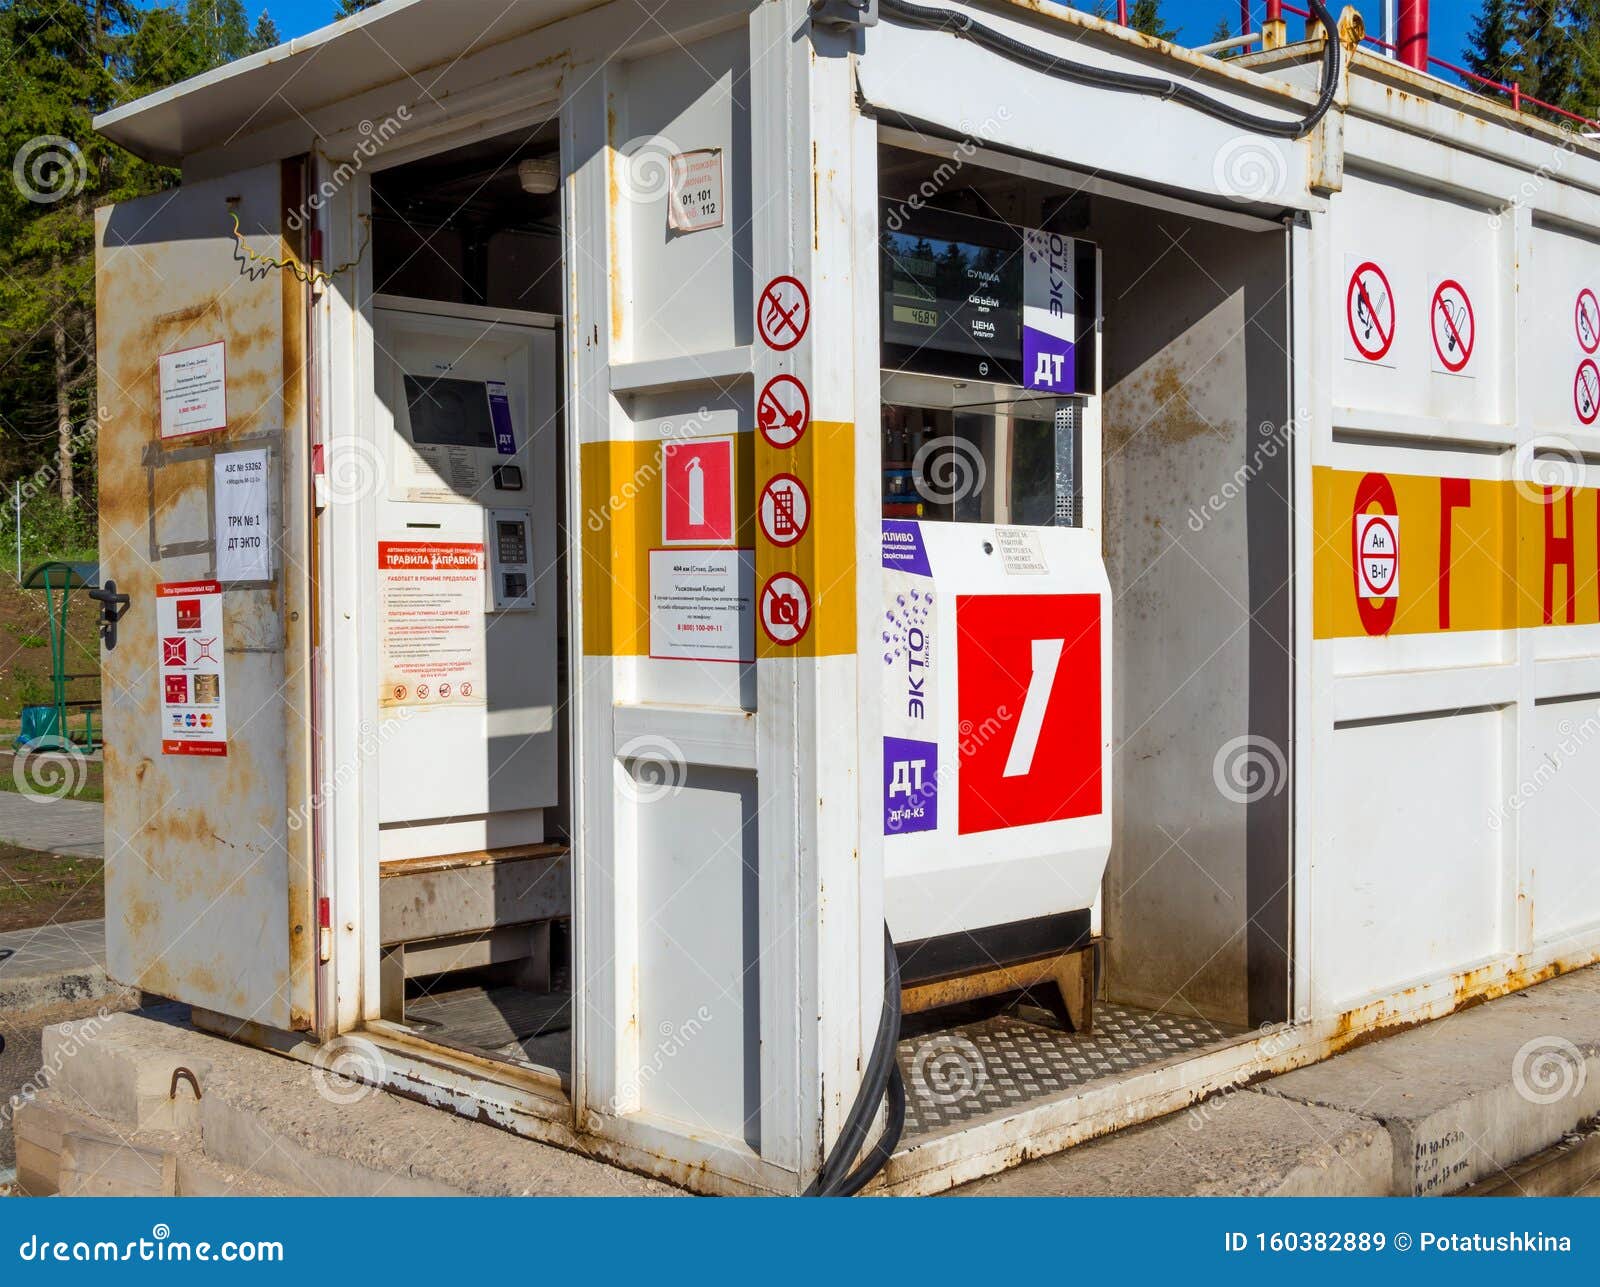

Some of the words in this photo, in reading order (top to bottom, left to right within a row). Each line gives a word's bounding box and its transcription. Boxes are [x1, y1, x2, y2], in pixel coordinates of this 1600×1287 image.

[682, 194, 695, 205] 01,
[697, 189, 711, 201] 101
[702, 203, 715, 215] 112
[967, 269, 1000, 283] СУММА
[1050, 233, 1063, 319] ЭКТО
[972, 320, 995, 332] ЦЕНА
[1034, 352, 1065, 386] ДТ
[499, 434, 511, 445] ДТ
[225, 464, 236, 472] АЗС
[228, 516, 242, 527] ТРК
[244, 516, 254, 526] №
[255, 515, 260, 526] 1
[228, 538, 239, 551] ДТ
[240, 537, 260, 548] ЭКТО
[1372, 534, 1384, 548] Ан
[387, 555, 429, 565] ПРАВИЛА
[431, 555, 477, 564] ЗАПРАВКИ
[908, 627, 924, 720] ЭКТО
[889, 759, 926, 798] ДТ
[890, 808, 925, 822] ДТ-Л-К5
